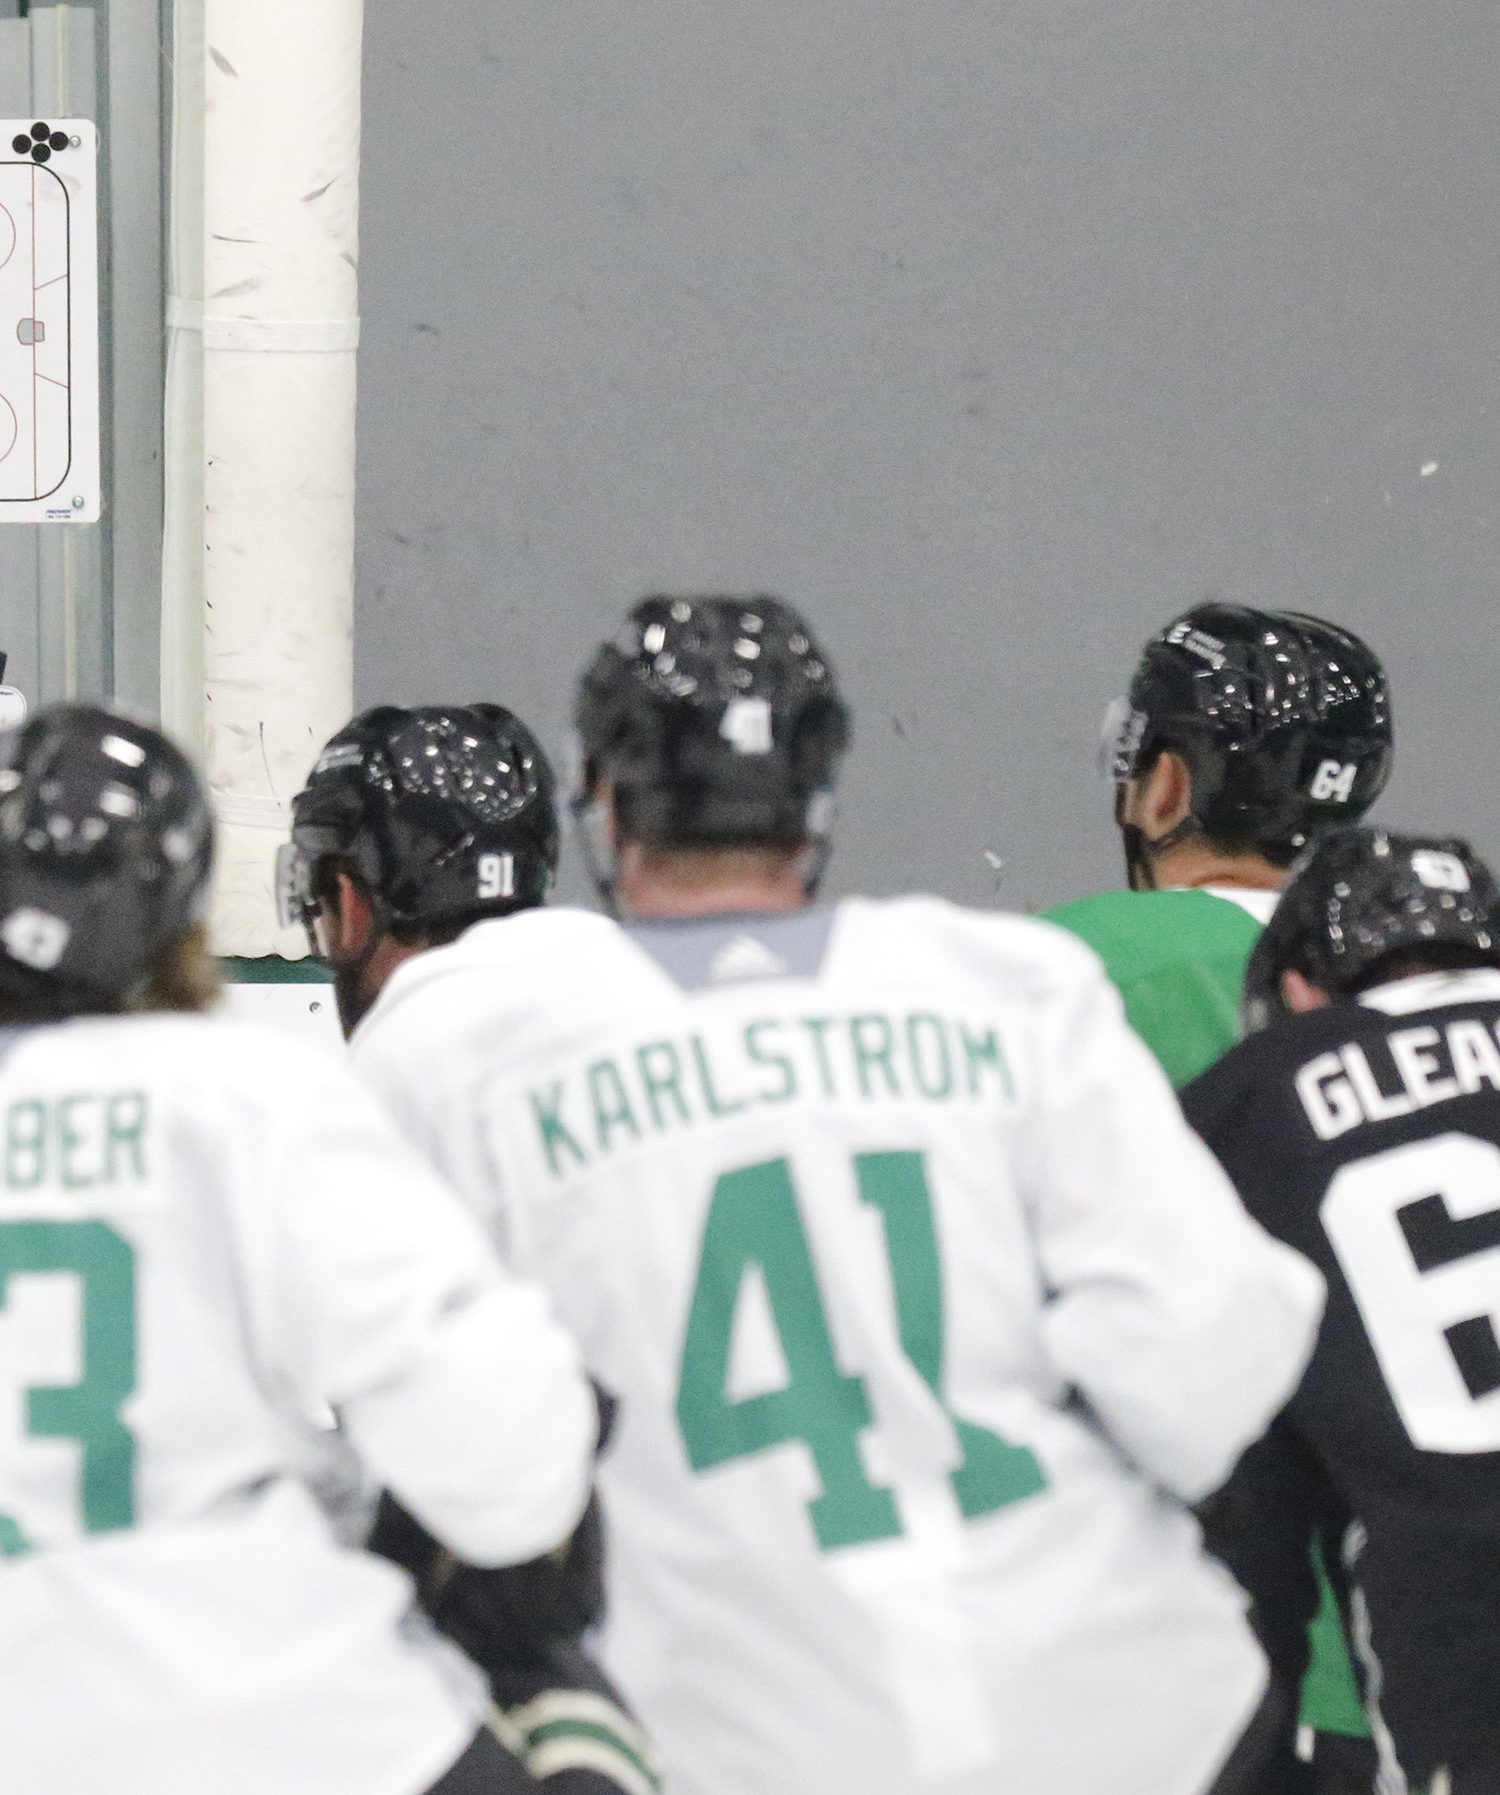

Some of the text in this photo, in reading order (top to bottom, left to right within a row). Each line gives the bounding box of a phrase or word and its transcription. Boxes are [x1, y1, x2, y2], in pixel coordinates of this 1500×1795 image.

[1310, 759, 1357, 802] 64
[477, 854, 515, 899] 91
[528, 1011, 1019, 1175] KARLSTROM
[1295, 1019, 1500, 1140] GLEA
[675, 1149, 1051, 1552] 41
